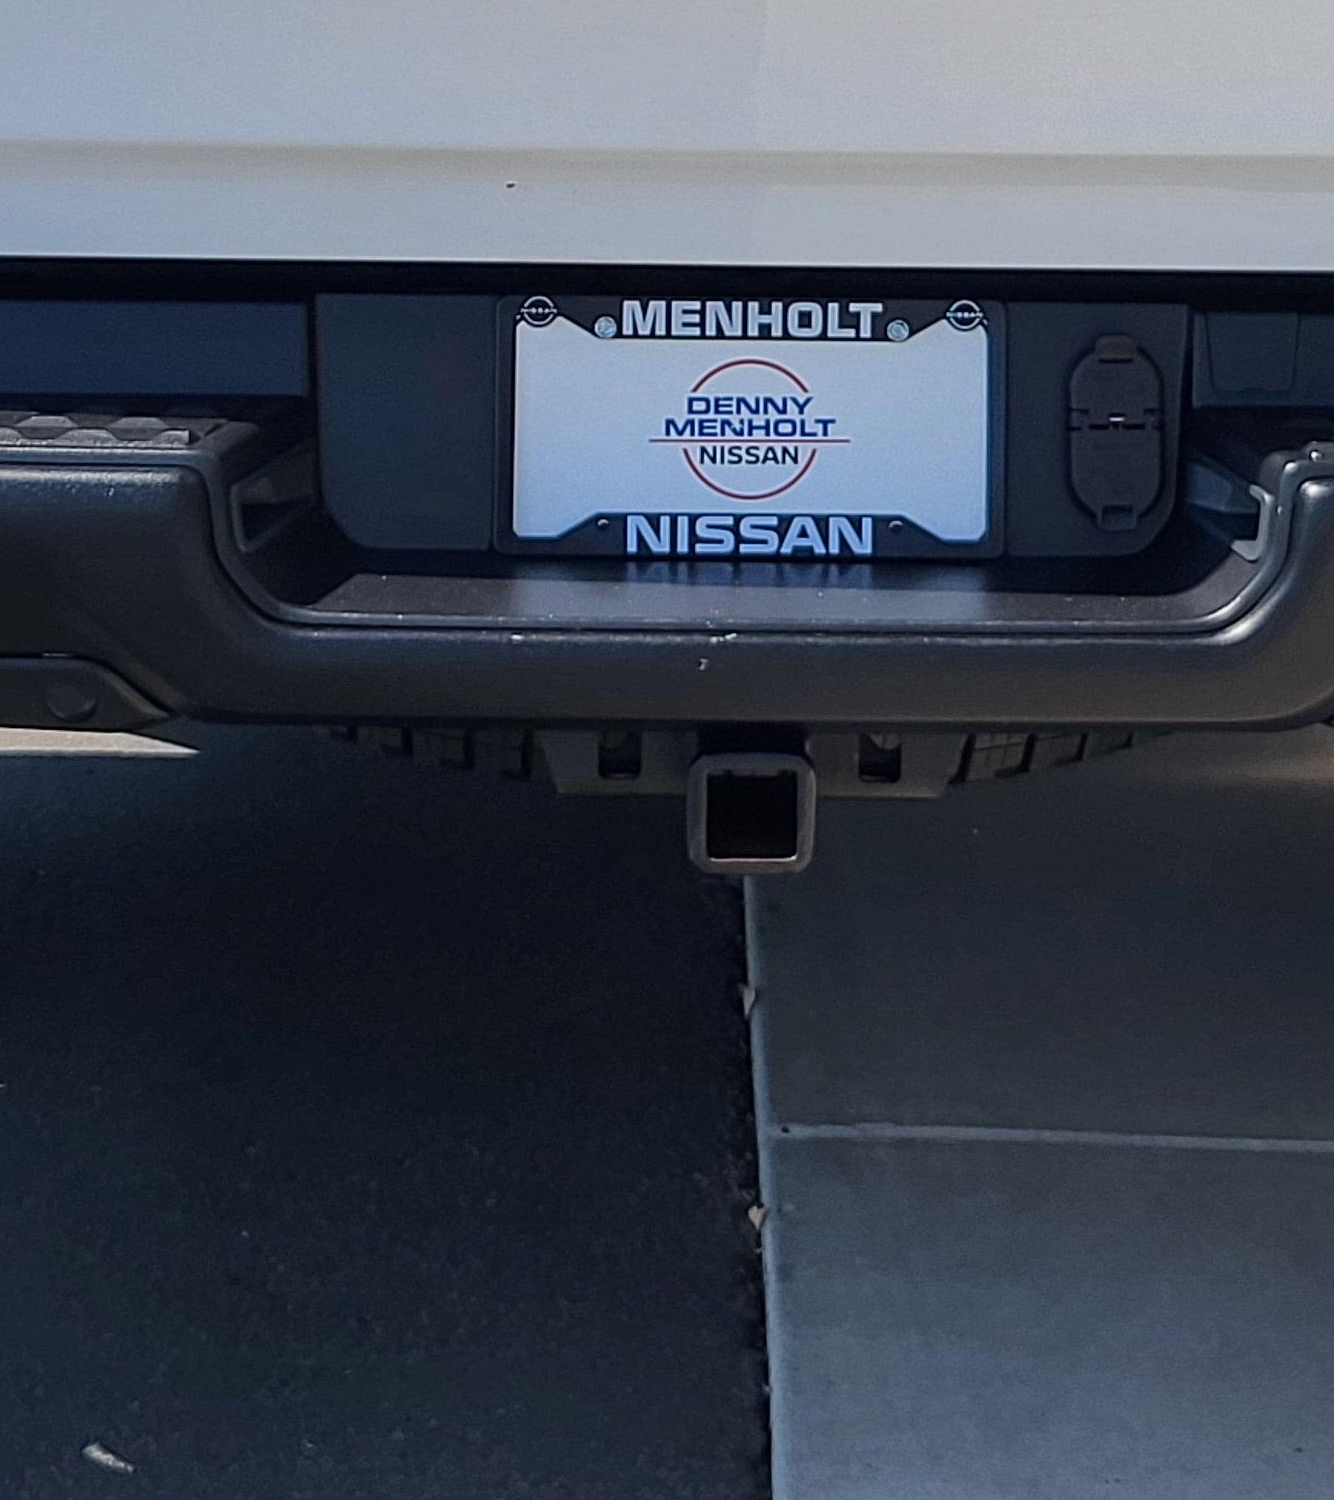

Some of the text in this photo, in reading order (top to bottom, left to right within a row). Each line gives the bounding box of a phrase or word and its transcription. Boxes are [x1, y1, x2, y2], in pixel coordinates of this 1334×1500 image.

[621, 299, 884, 338] MENHOLT
[686, 396, 814, 416] DENNY
[664, 418, 837, 438] MENHOLT
[698, 445, 800, 466] NISSAN
[625, 514, 874, 555] NISSAN
